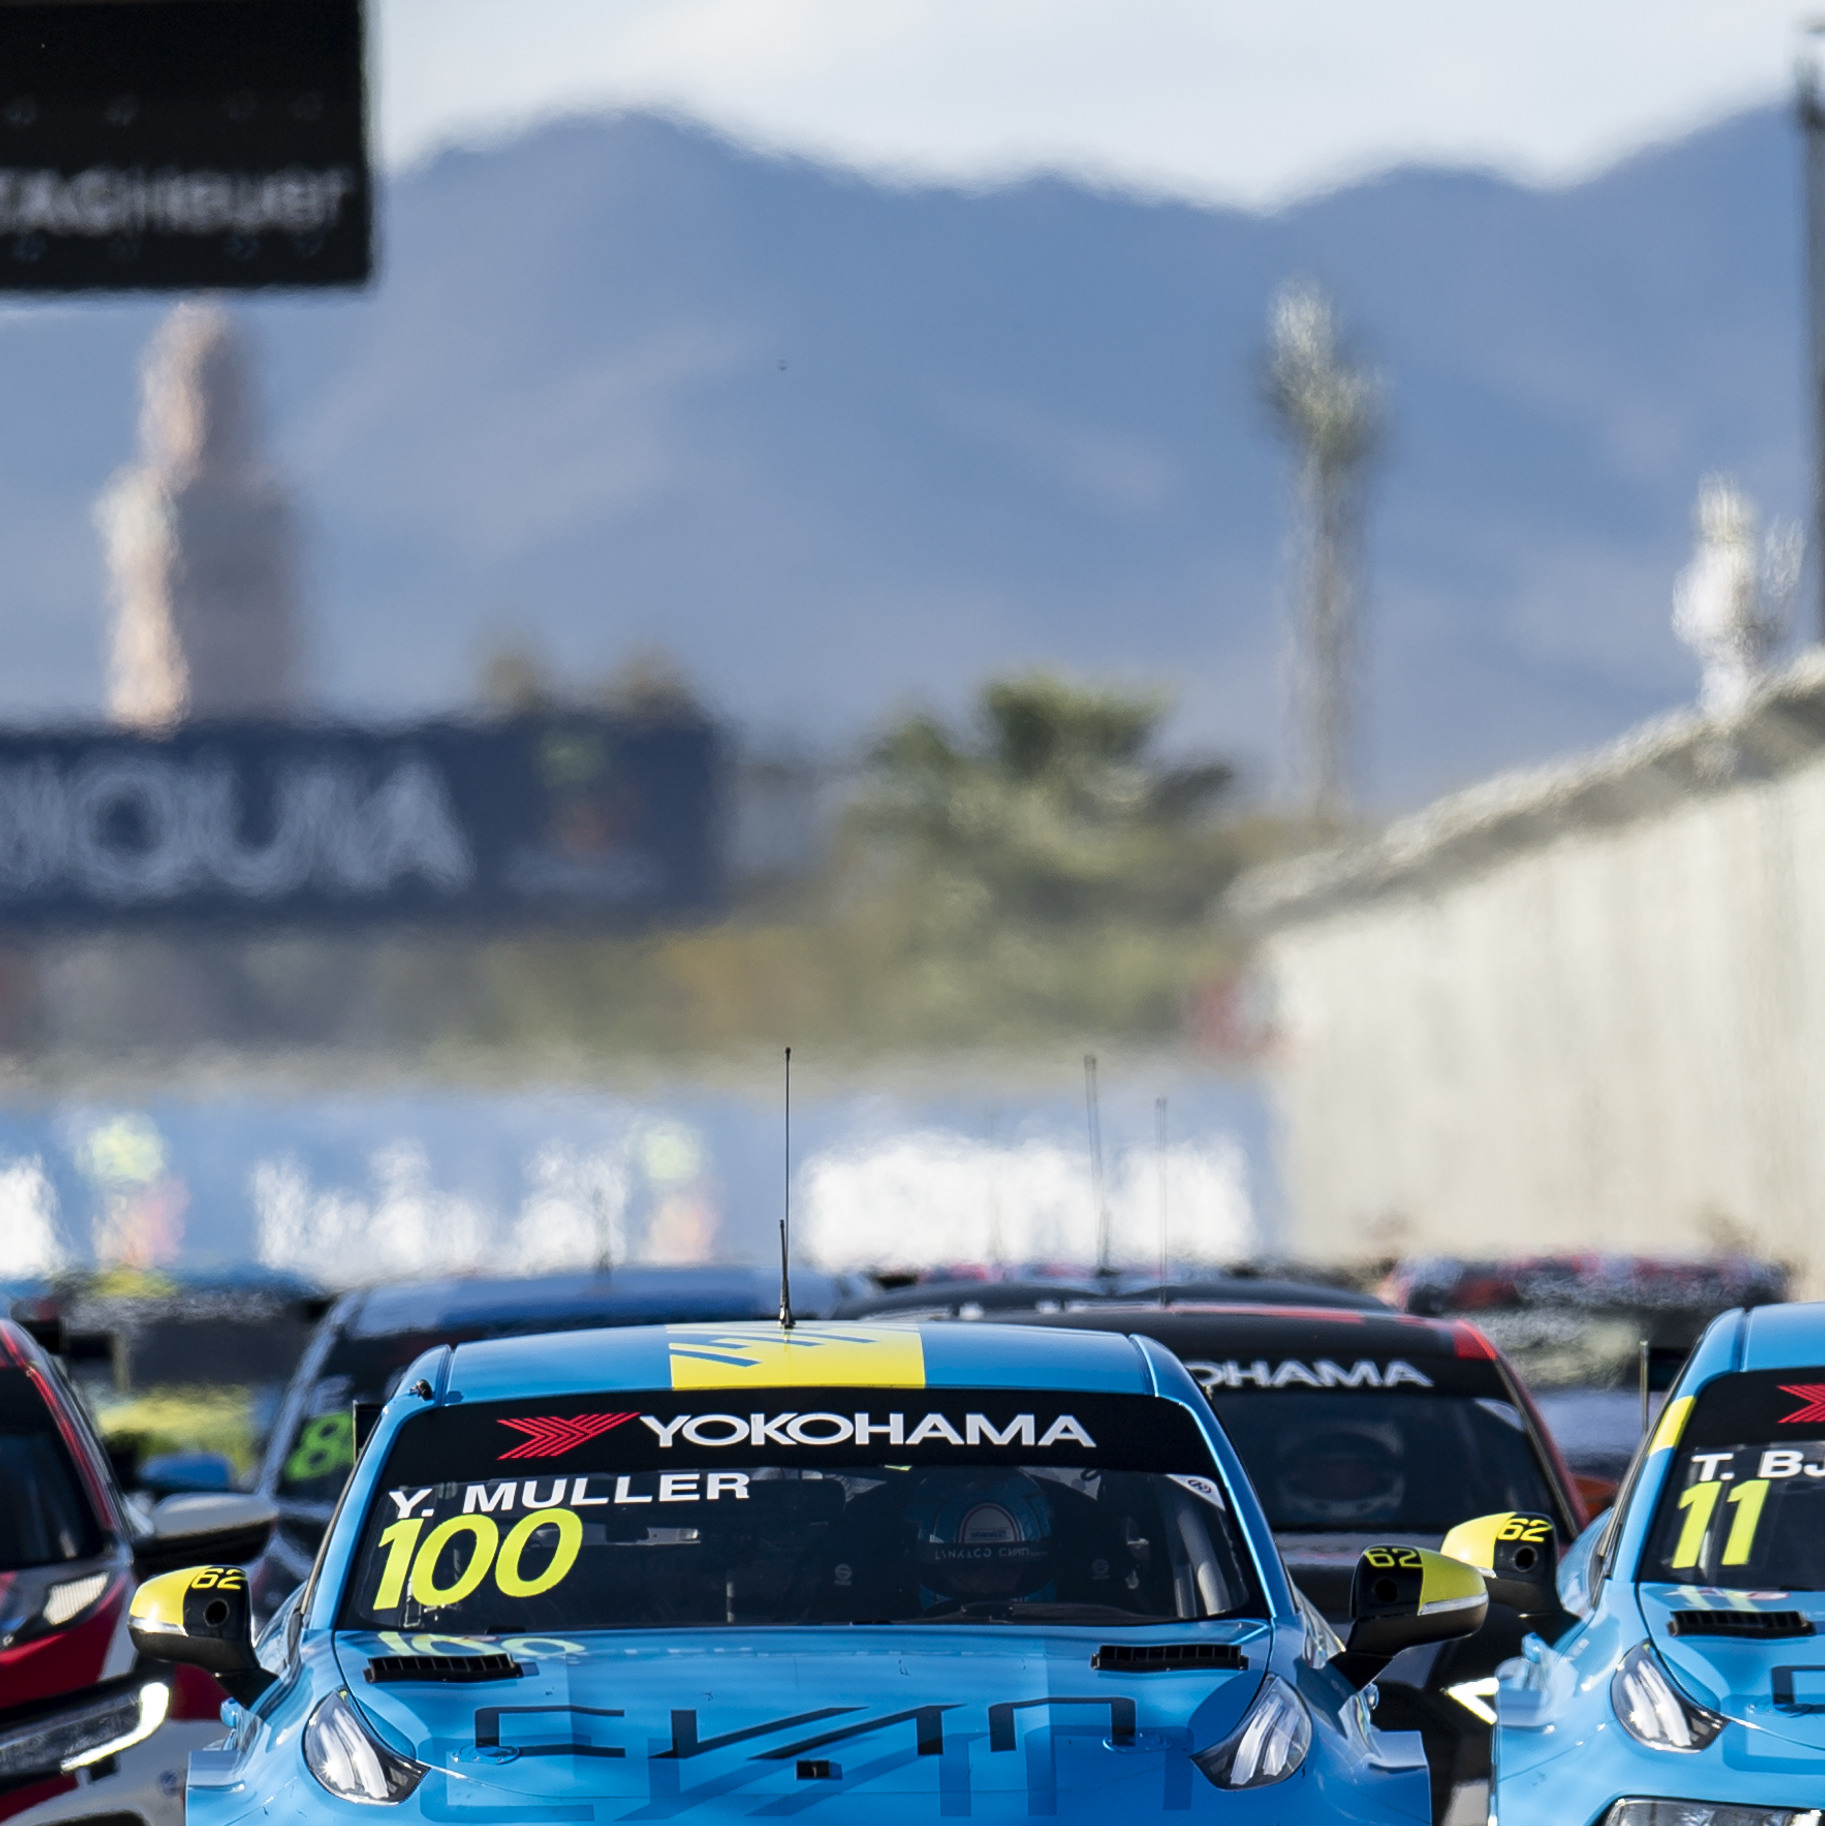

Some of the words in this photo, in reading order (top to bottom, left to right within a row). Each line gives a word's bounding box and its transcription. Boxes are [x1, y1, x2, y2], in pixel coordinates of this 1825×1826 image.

[639, 1412, 1097, 1448] YOKOHAMA
[1691, 1453, 1735, 1482] T.
[389, 1488, 434, 1519] Y.
[462, 1473, 750, 1514] MULLER
[1497, 1518, 1554, 1542] 62
[1671, 1479, 1771, 1569] 11
[373, 1508, 583, 1611] 100
[1364, 1548, 1423, 1568] 62
[191, 1568, 248, 1589] 62
